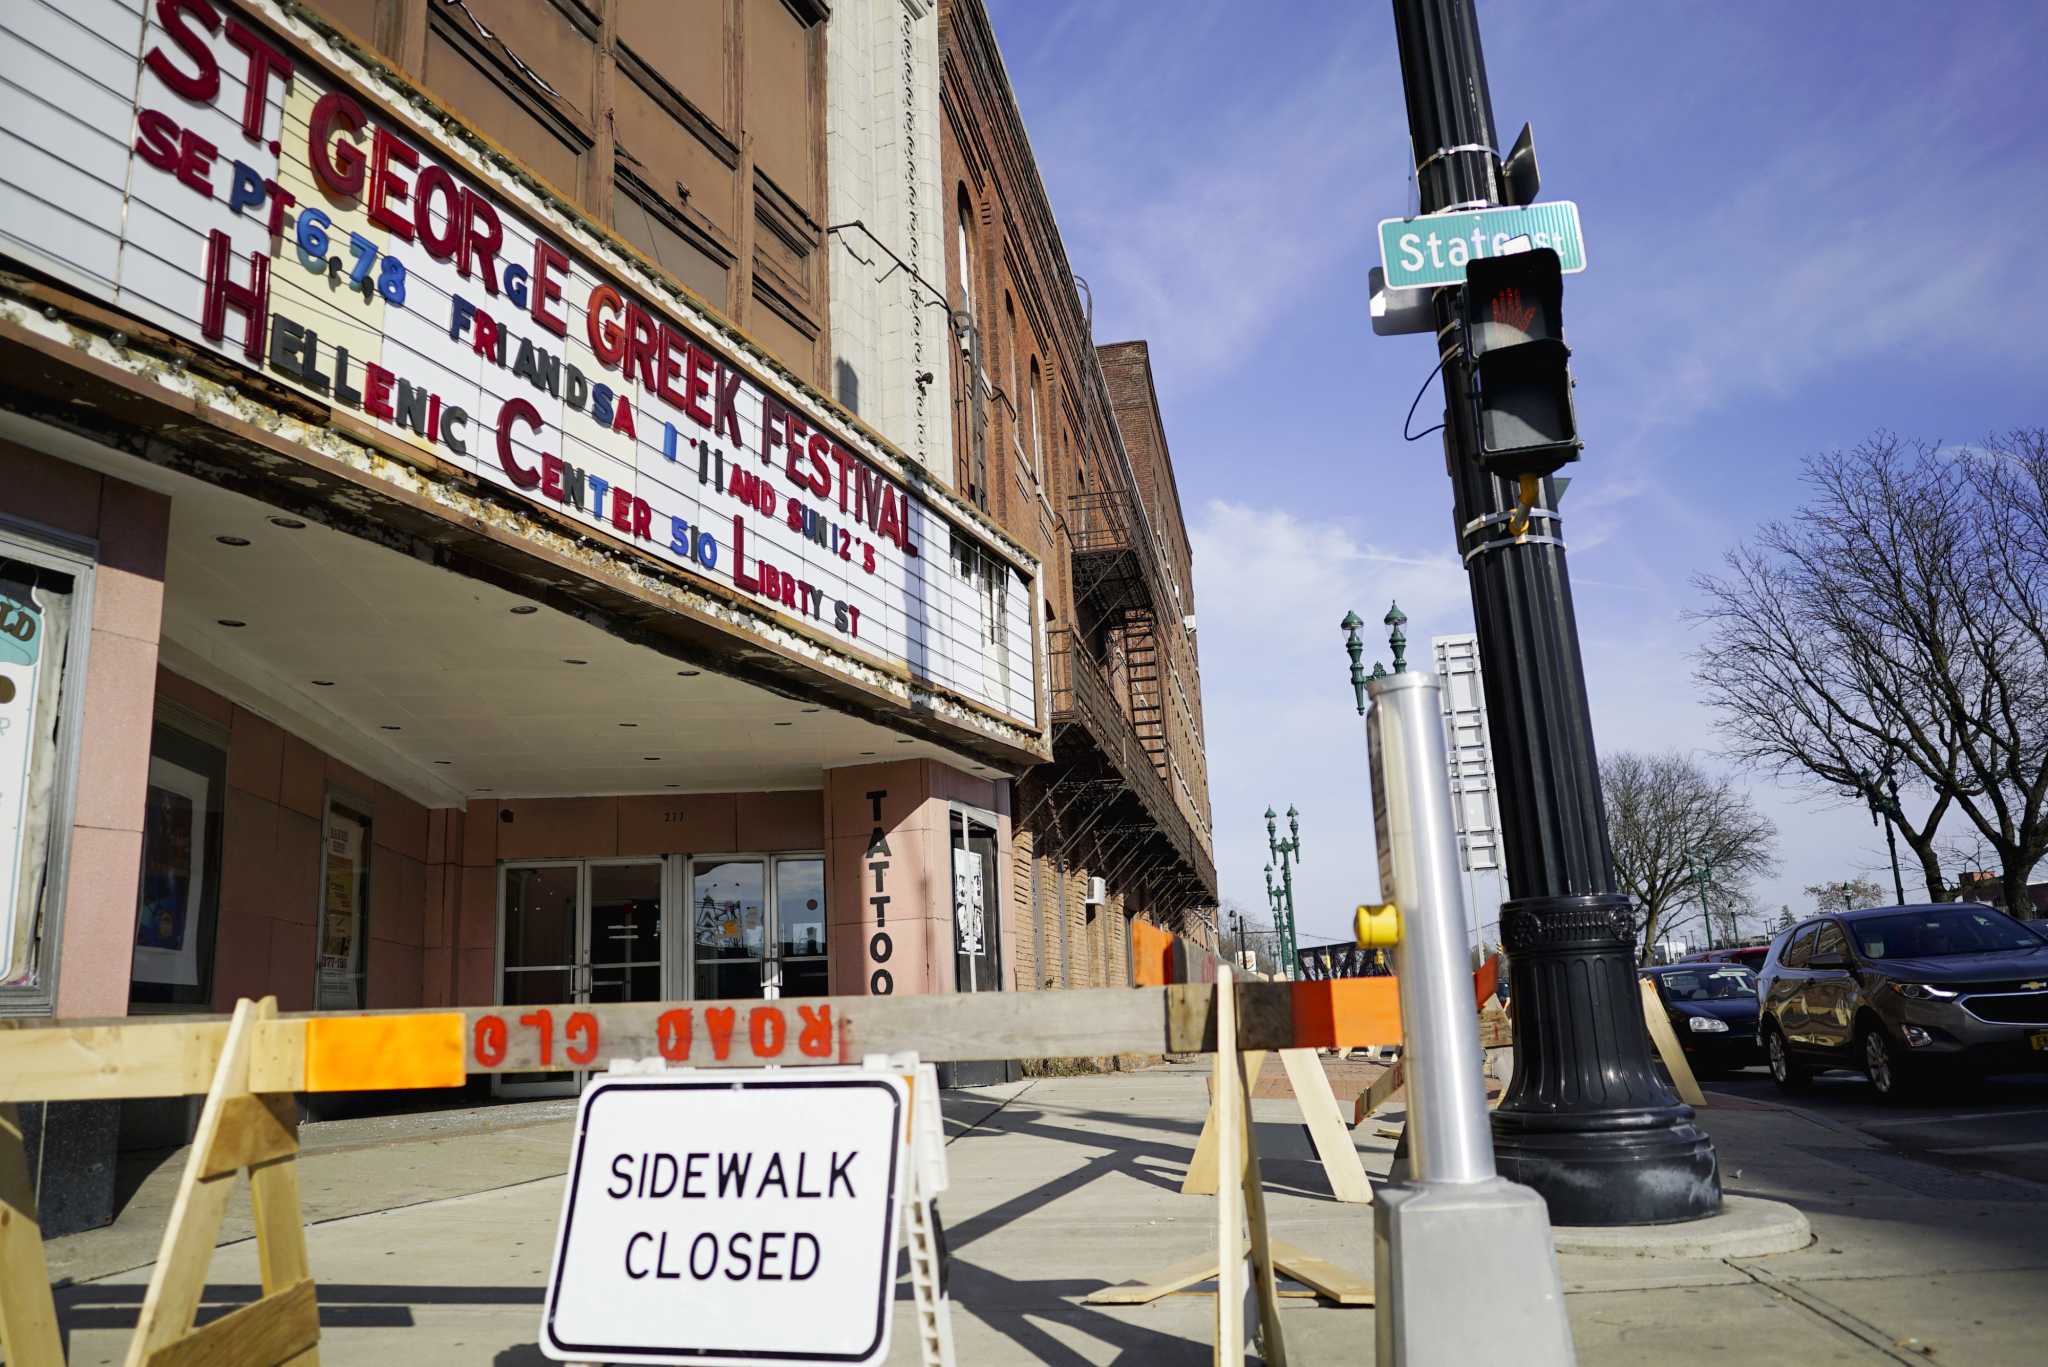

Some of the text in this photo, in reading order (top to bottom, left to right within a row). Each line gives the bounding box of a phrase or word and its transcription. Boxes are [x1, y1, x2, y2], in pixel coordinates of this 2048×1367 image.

[135, 109, 296, 236] SEPT
[450, 294, 507, 369] FRI
[512, 337, 588, 412] AND
[728, 464, 777, 518] AND
[786, 498, 828, 548] SUN
[144, 0, 918, 557] ST. GEORGE GREEK FESTIVAL
[202, 229, 861, 639] HELLENIC CENTER 510 LIBRTY ST
[865, 790, 894, 996] TATTOO
[657, 1004, 833, 1061] ROAD
[606, 1151, 859, 1200] SIDEWALK
[625, 1231, 821, 1281] CLOSED
